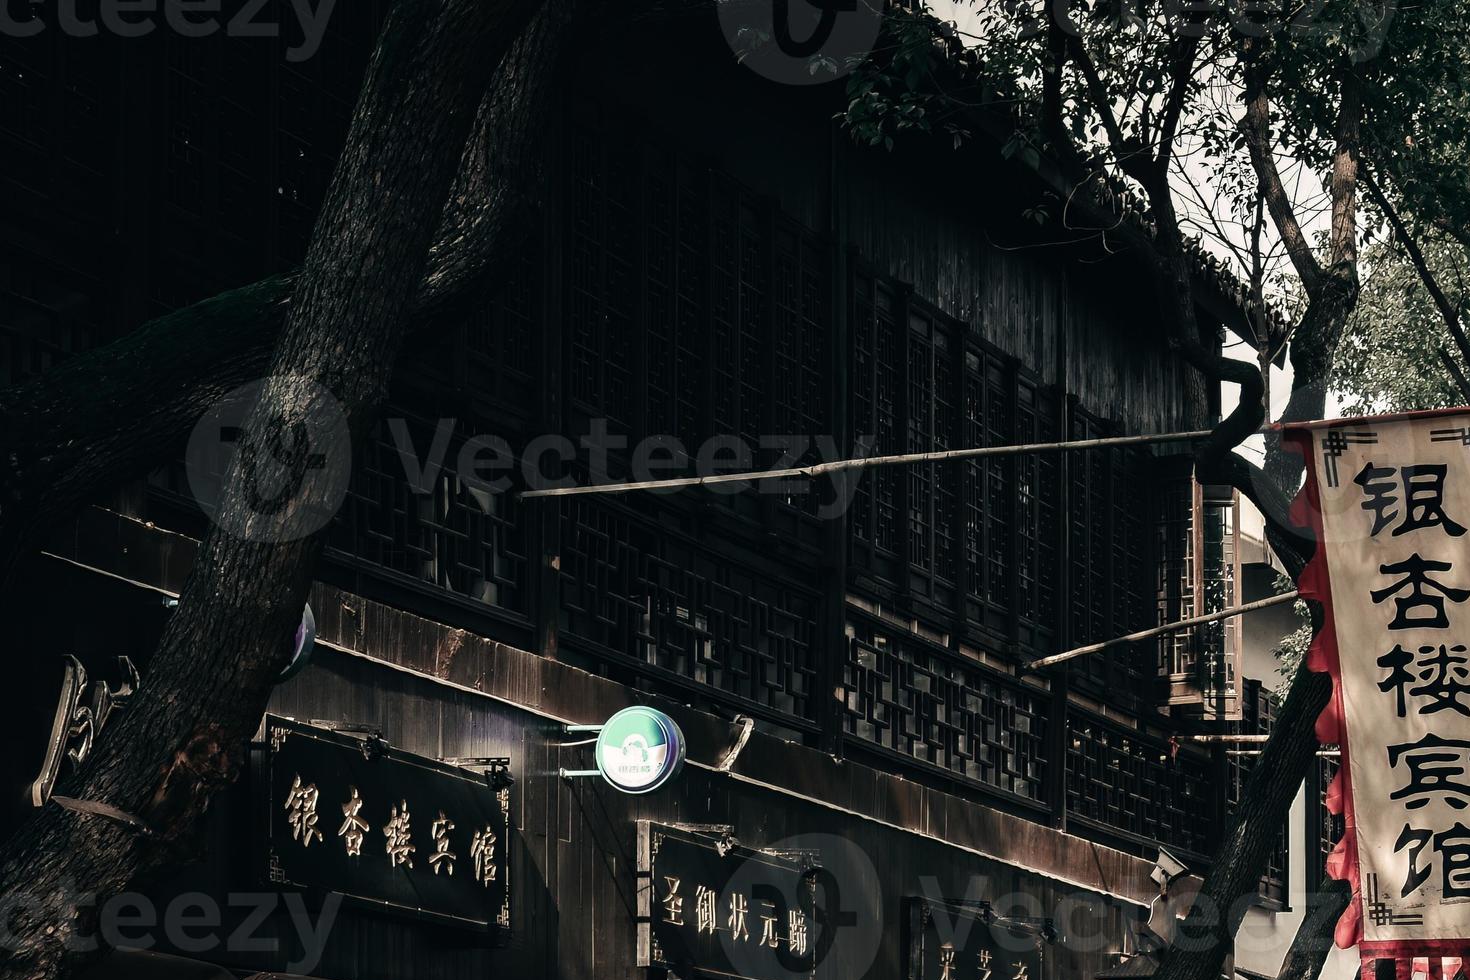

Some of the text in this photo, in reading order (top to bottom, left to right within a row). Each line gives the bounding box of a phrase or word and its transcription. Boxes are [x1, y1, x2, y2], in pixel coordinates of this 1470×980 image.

[662, 876, 808, 956] 圣御状元蹄
